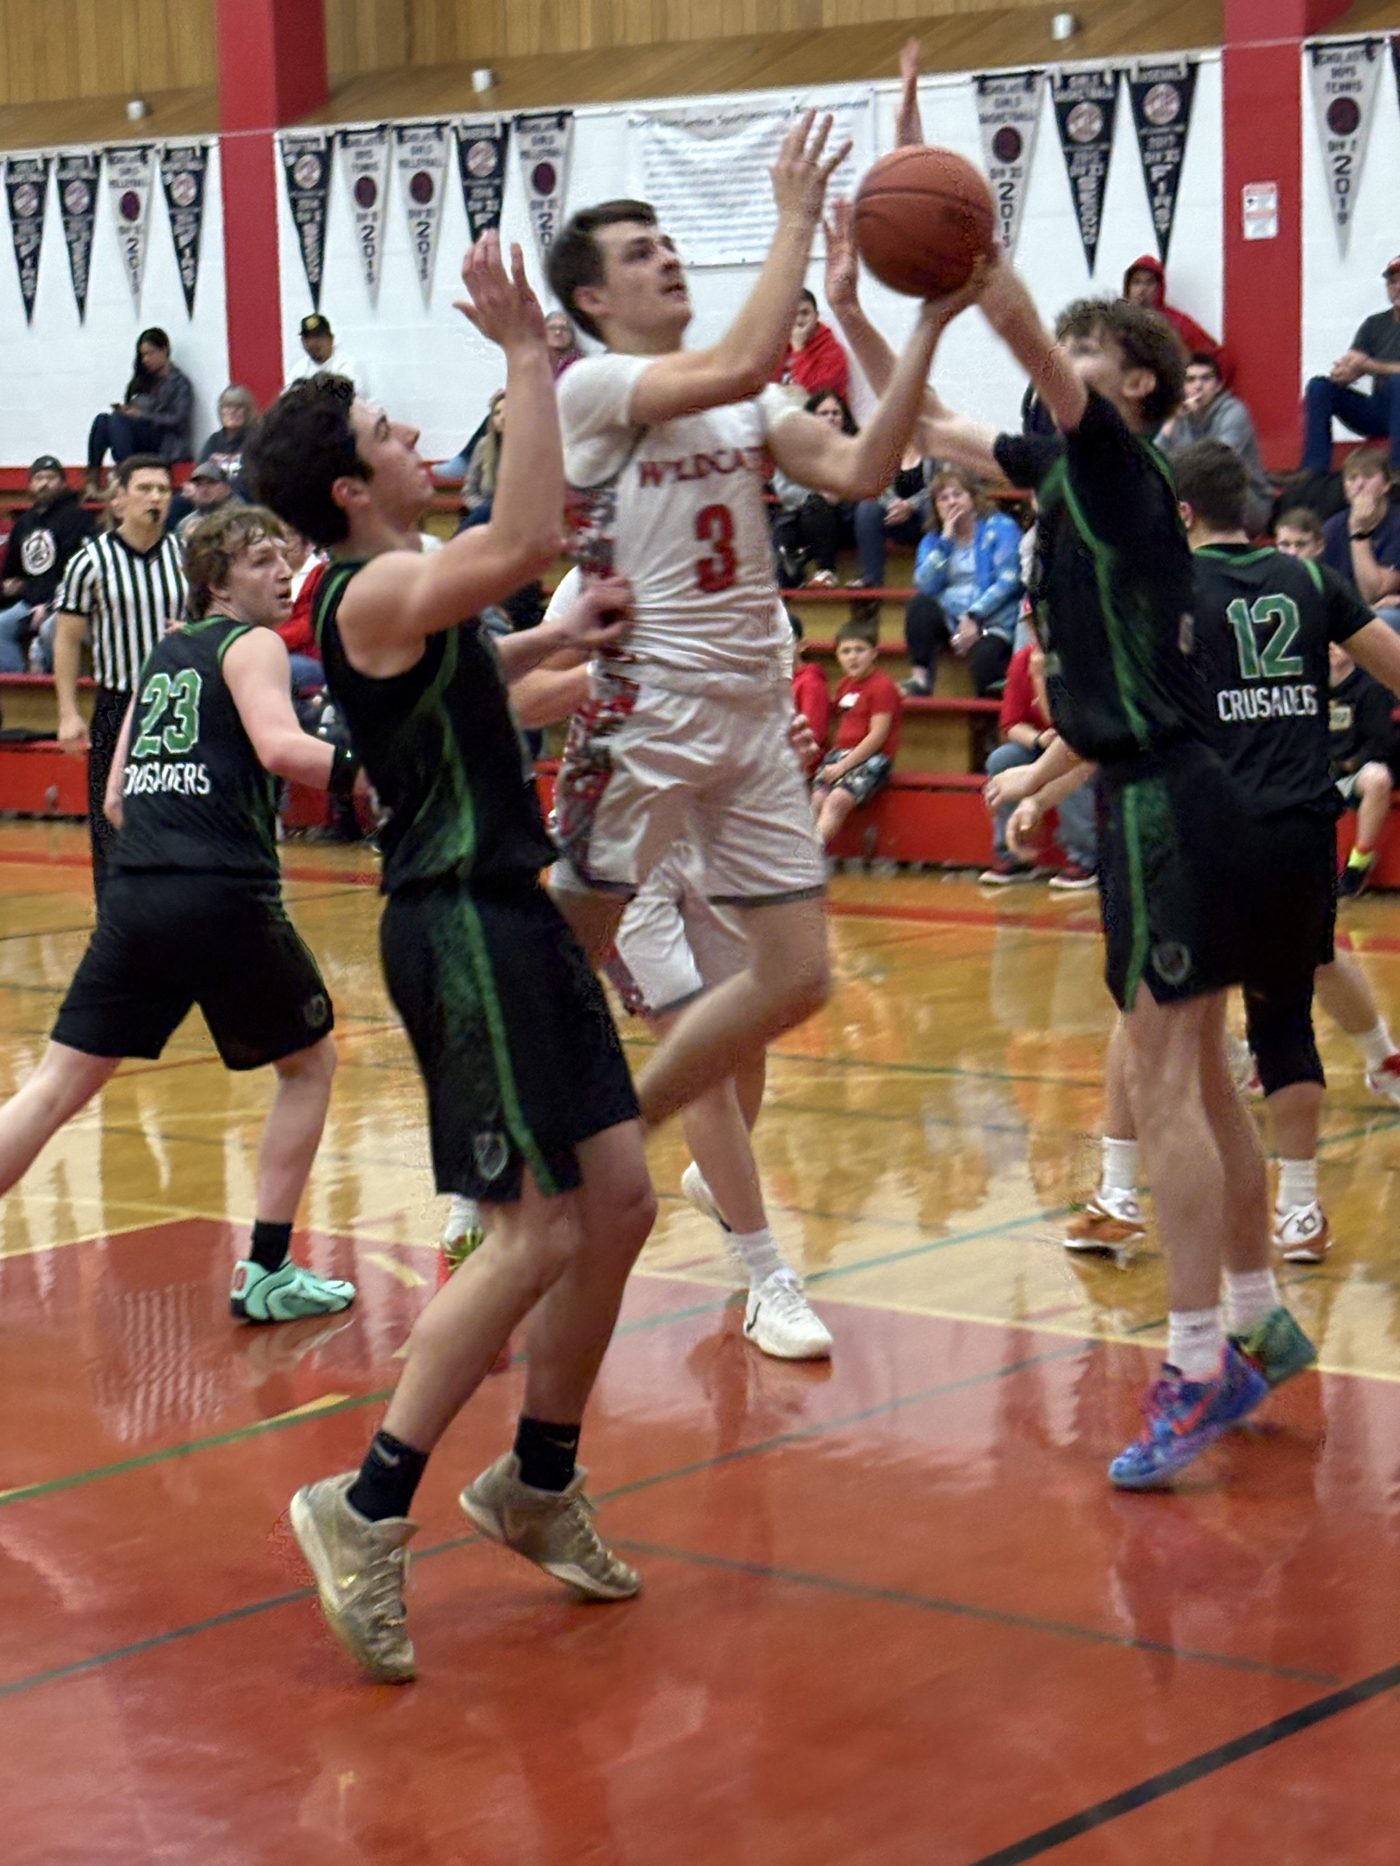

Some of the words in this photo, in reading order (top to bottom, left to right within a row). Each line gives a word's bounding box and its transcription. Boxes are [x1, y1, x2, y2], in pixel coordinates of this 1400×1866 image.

[694, 503, 738, 593] 3
[1225, 592, 1304, 680] 12
[130, 667, 202, 758] 23
